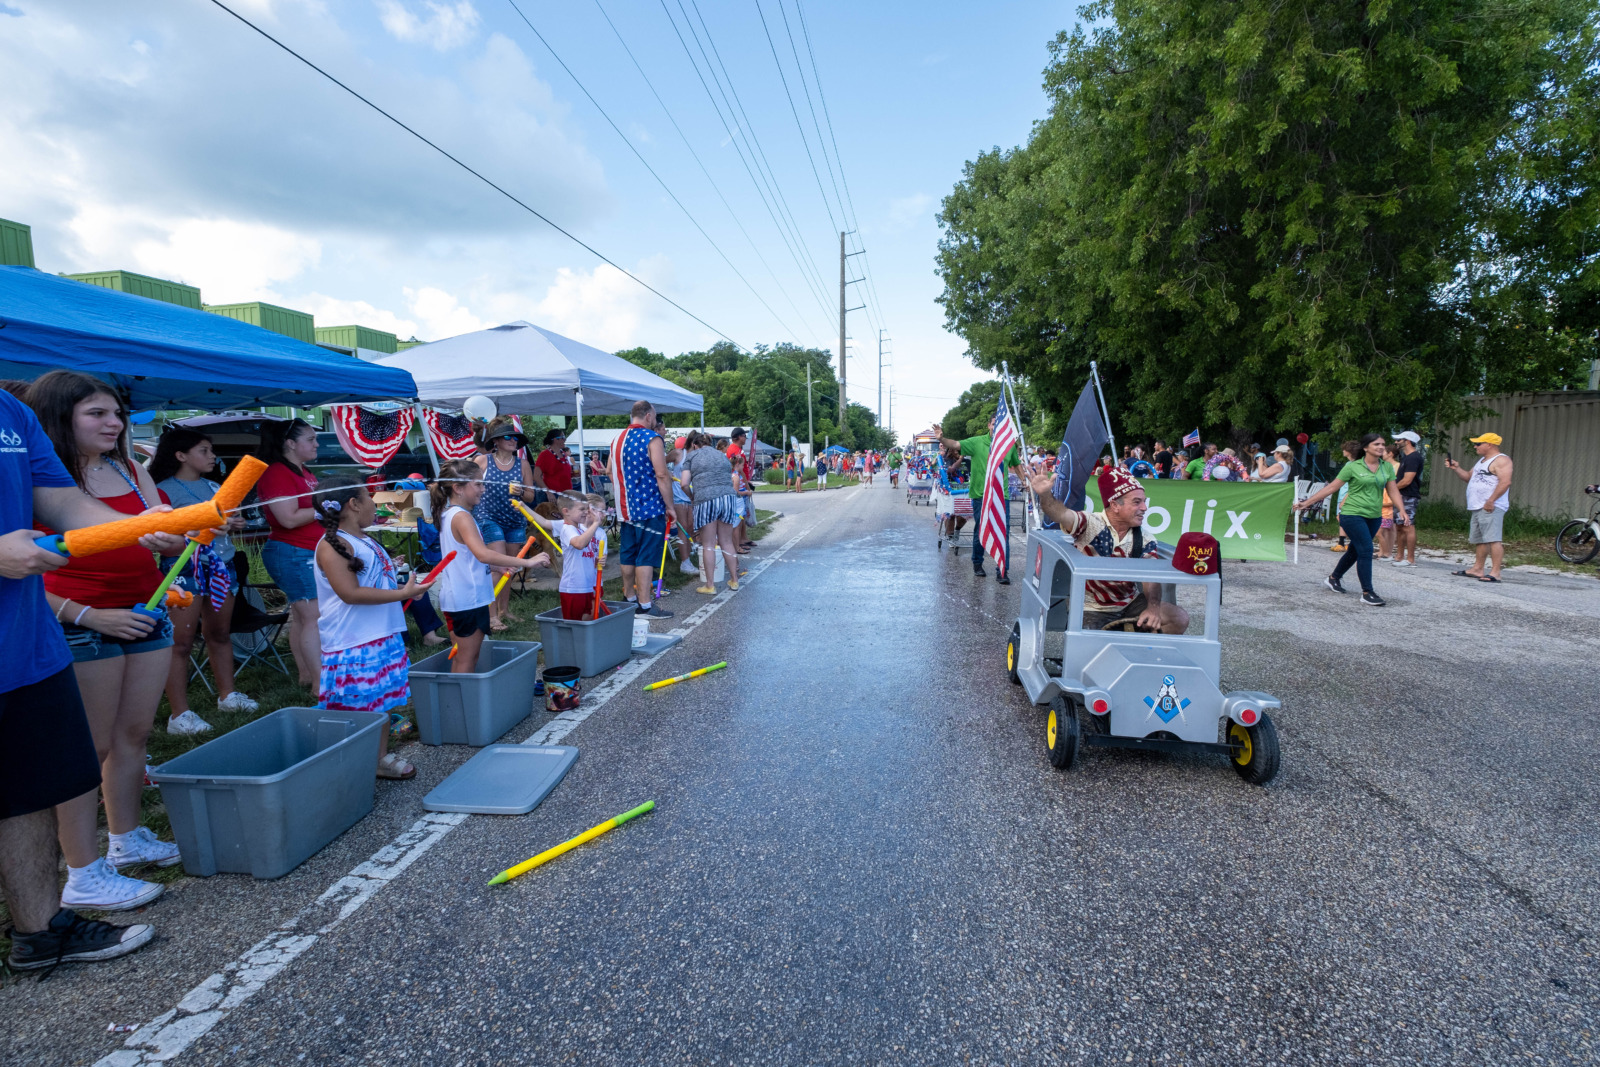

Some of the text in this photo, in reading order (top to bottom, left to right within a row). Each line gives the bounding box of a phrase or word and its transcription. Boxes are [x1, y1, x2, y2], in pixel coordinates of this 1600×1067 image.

[1085, 495, 1251, 540] blix
[172, 576, 187, 585] SA
[1162, 696, 1172, 710] G
